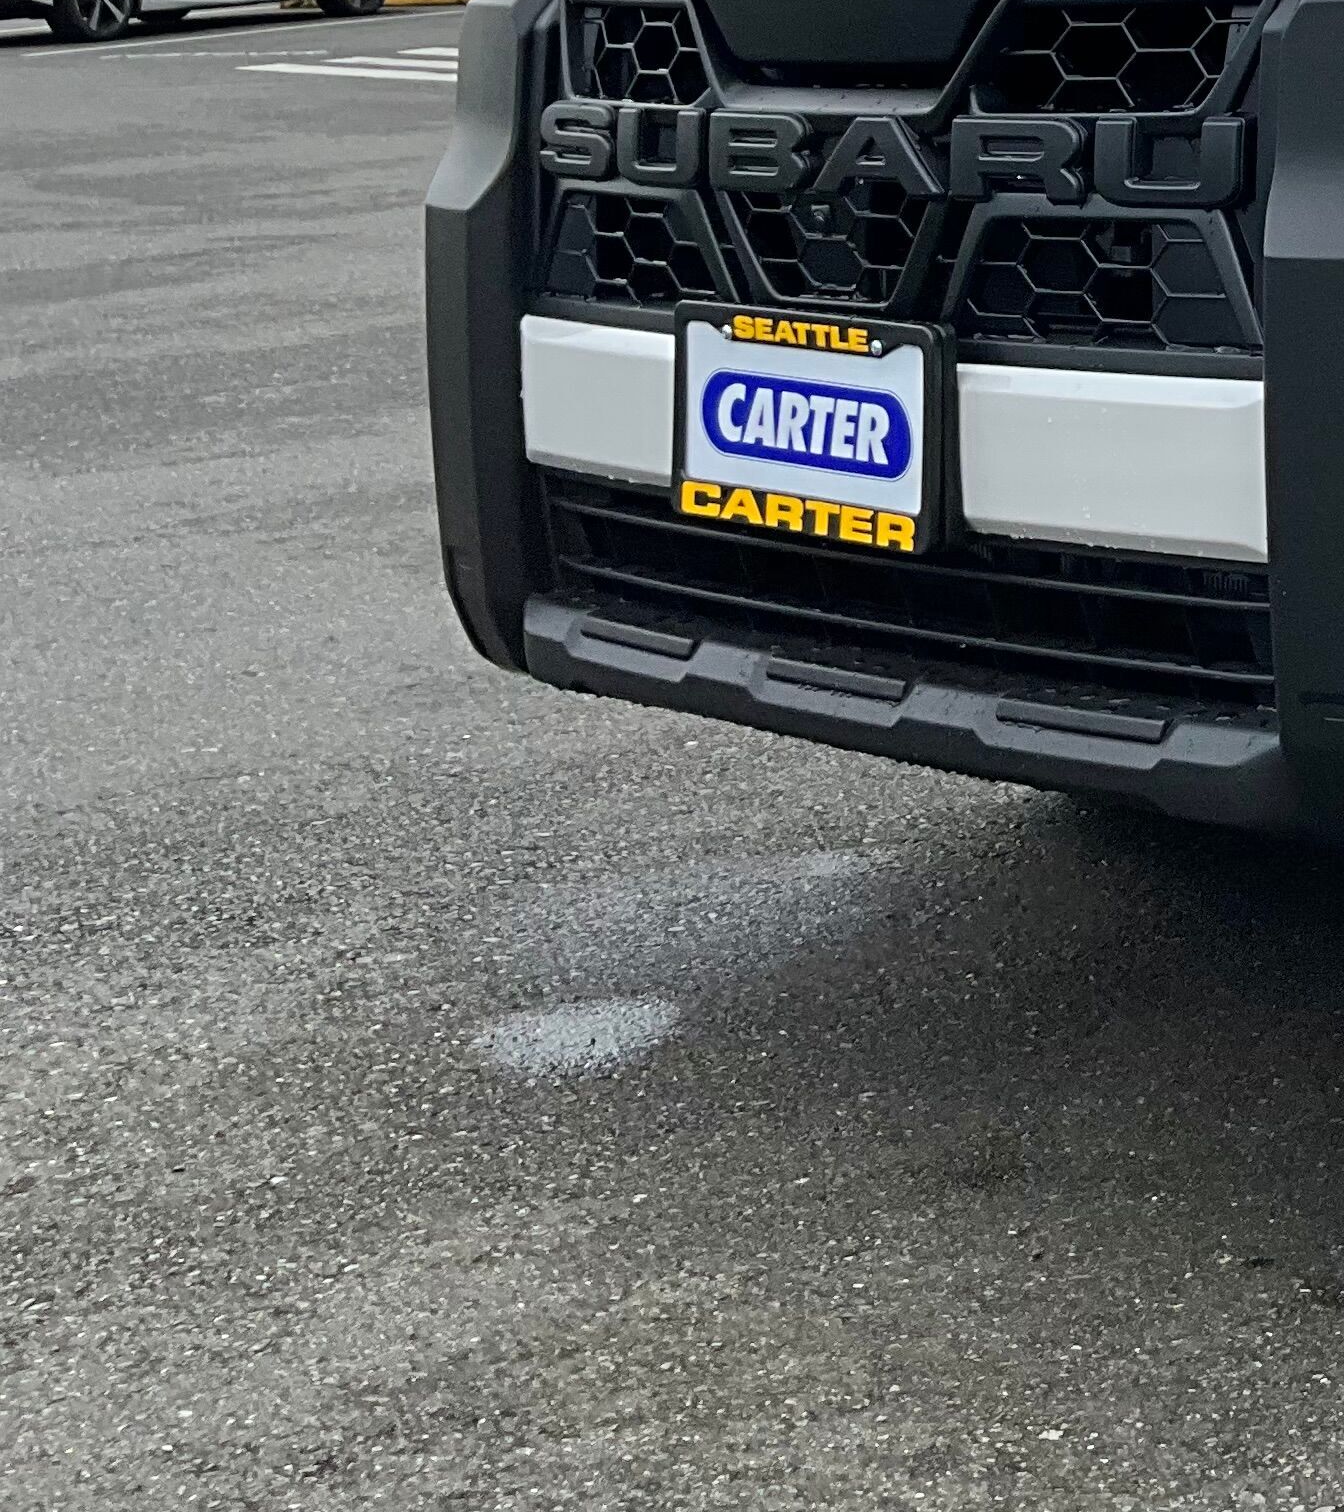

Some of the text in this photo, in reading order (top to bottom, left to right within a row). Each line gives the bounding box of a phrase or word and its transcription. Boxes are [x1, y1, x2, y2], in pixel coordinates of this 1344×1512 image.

[541, 100, 1254, 207] SUBARU
[733, 314, 870, 354] SEATTLE
[717, 380, 891, 466] CARTER
[681, 480, 916, 553] CARTER
